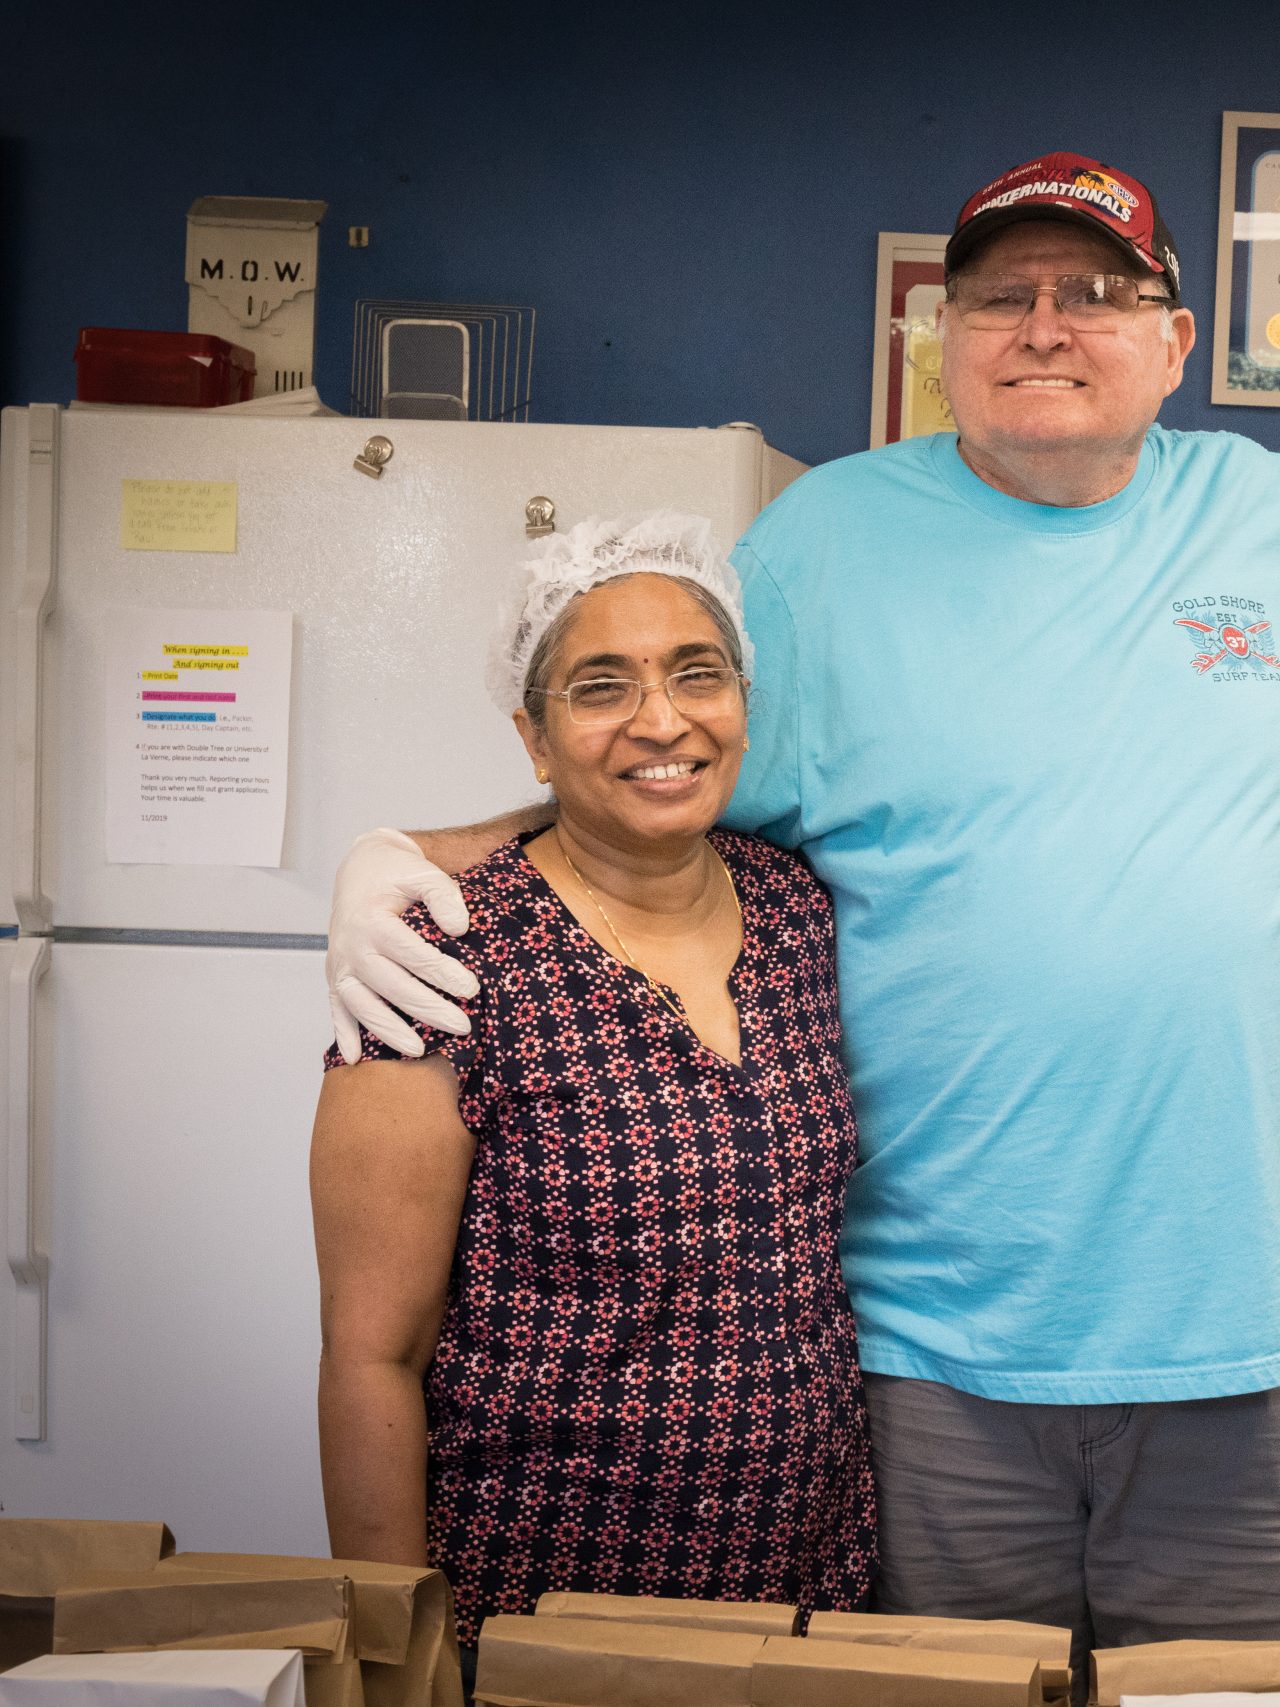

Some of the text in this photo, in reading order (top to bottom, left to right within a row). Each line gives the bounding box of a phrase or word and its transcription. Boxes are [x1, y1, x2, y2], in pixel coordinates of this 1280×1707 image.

[1008, 162, 1042, 180] ANNUAL
[1172, 595, 1265, 614] GOLD SHORE
[1216, 613, 1237, 622] EST
[1226, 637, 1246, 648] 37
[164, 645, 187, 654] When
[190, 648, 219, 657] signing
[174, 660, 191, 669] And
[194, 662, 223, 671] signing
[1212, 672, 1249, 682] SURF
[172, 754, 191, 762] please
[210, 776, 239, 784] Reporting
[141, 784, 157, 792] helps
[218, 786, 234, 794] grant
